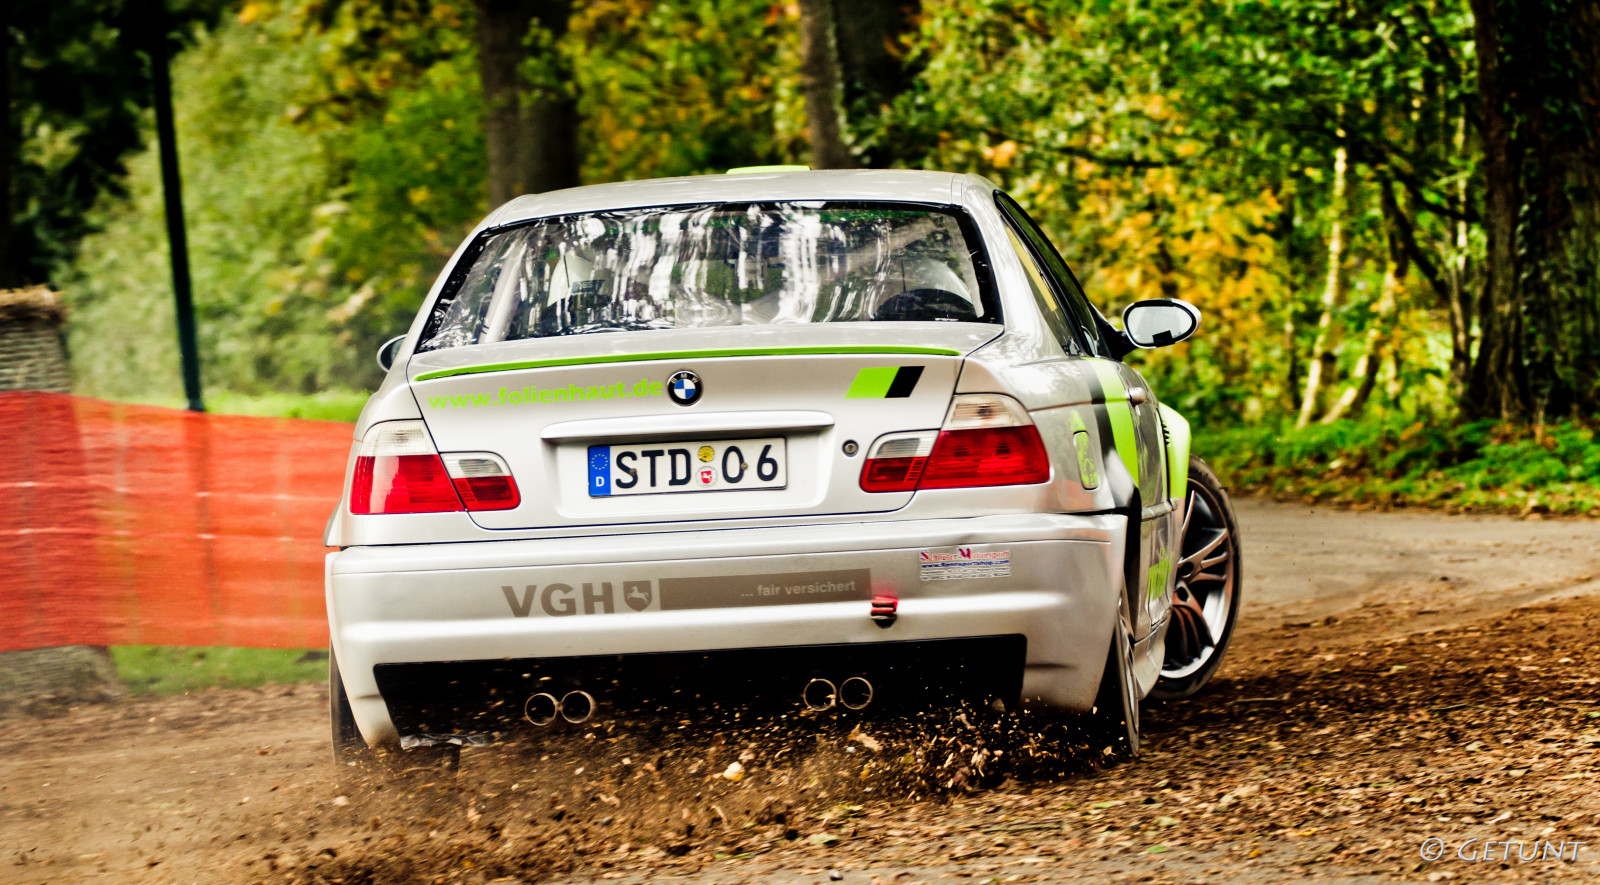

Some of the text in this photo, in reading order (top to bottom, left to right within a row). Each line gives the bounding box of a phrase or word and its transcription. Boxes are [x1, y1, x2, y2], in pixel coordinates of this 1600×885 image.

[428, 378, 663, 410] www.folienhaut.de
[595, 476, 605, 487] D
[615, 448, 691, 489] STD
[501, 582, 615, 618] VGH
[757, 584, 781, 596] fair
[785, 580, 857, 595] versichert
